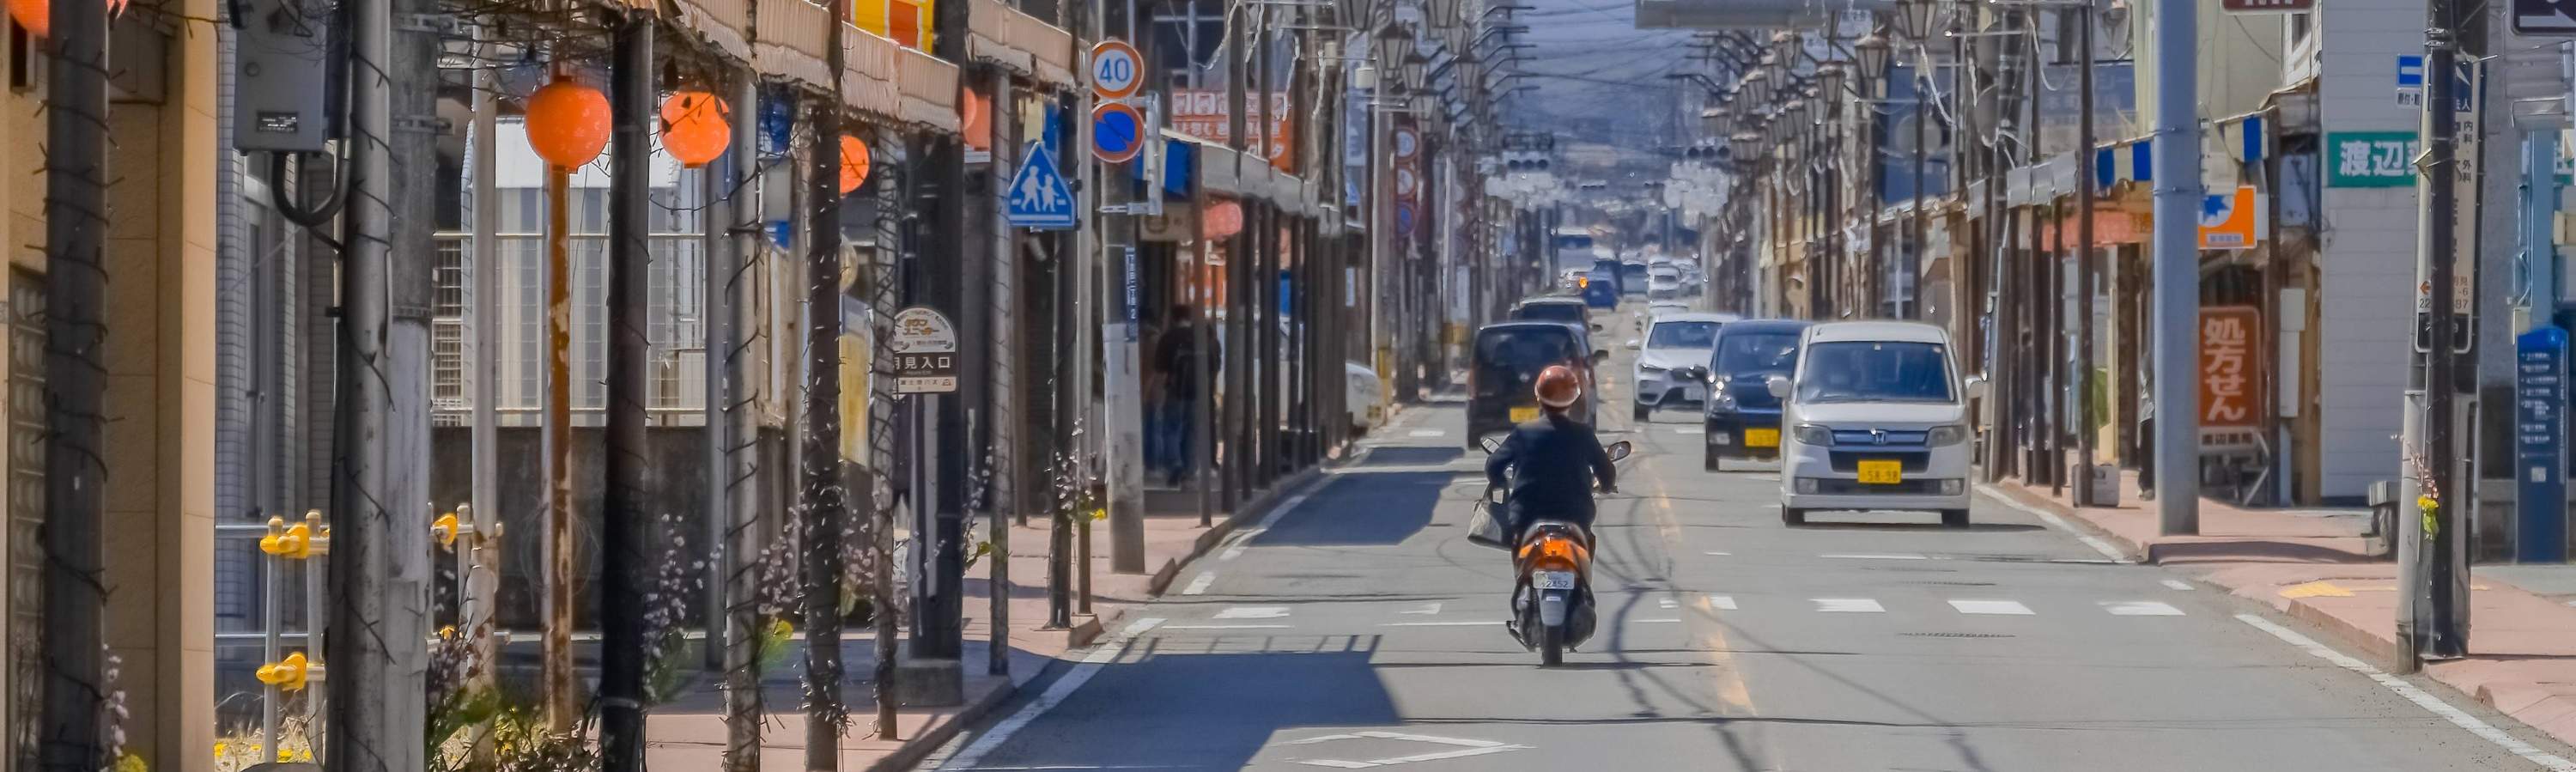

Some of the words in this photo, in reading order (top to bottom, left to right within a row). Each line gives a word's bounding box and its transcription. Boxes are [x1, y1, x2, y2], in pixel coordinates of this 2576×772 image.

[1099, 58, 1129, 83] 40
[2204, 317, 2247, 421] 処方せん
